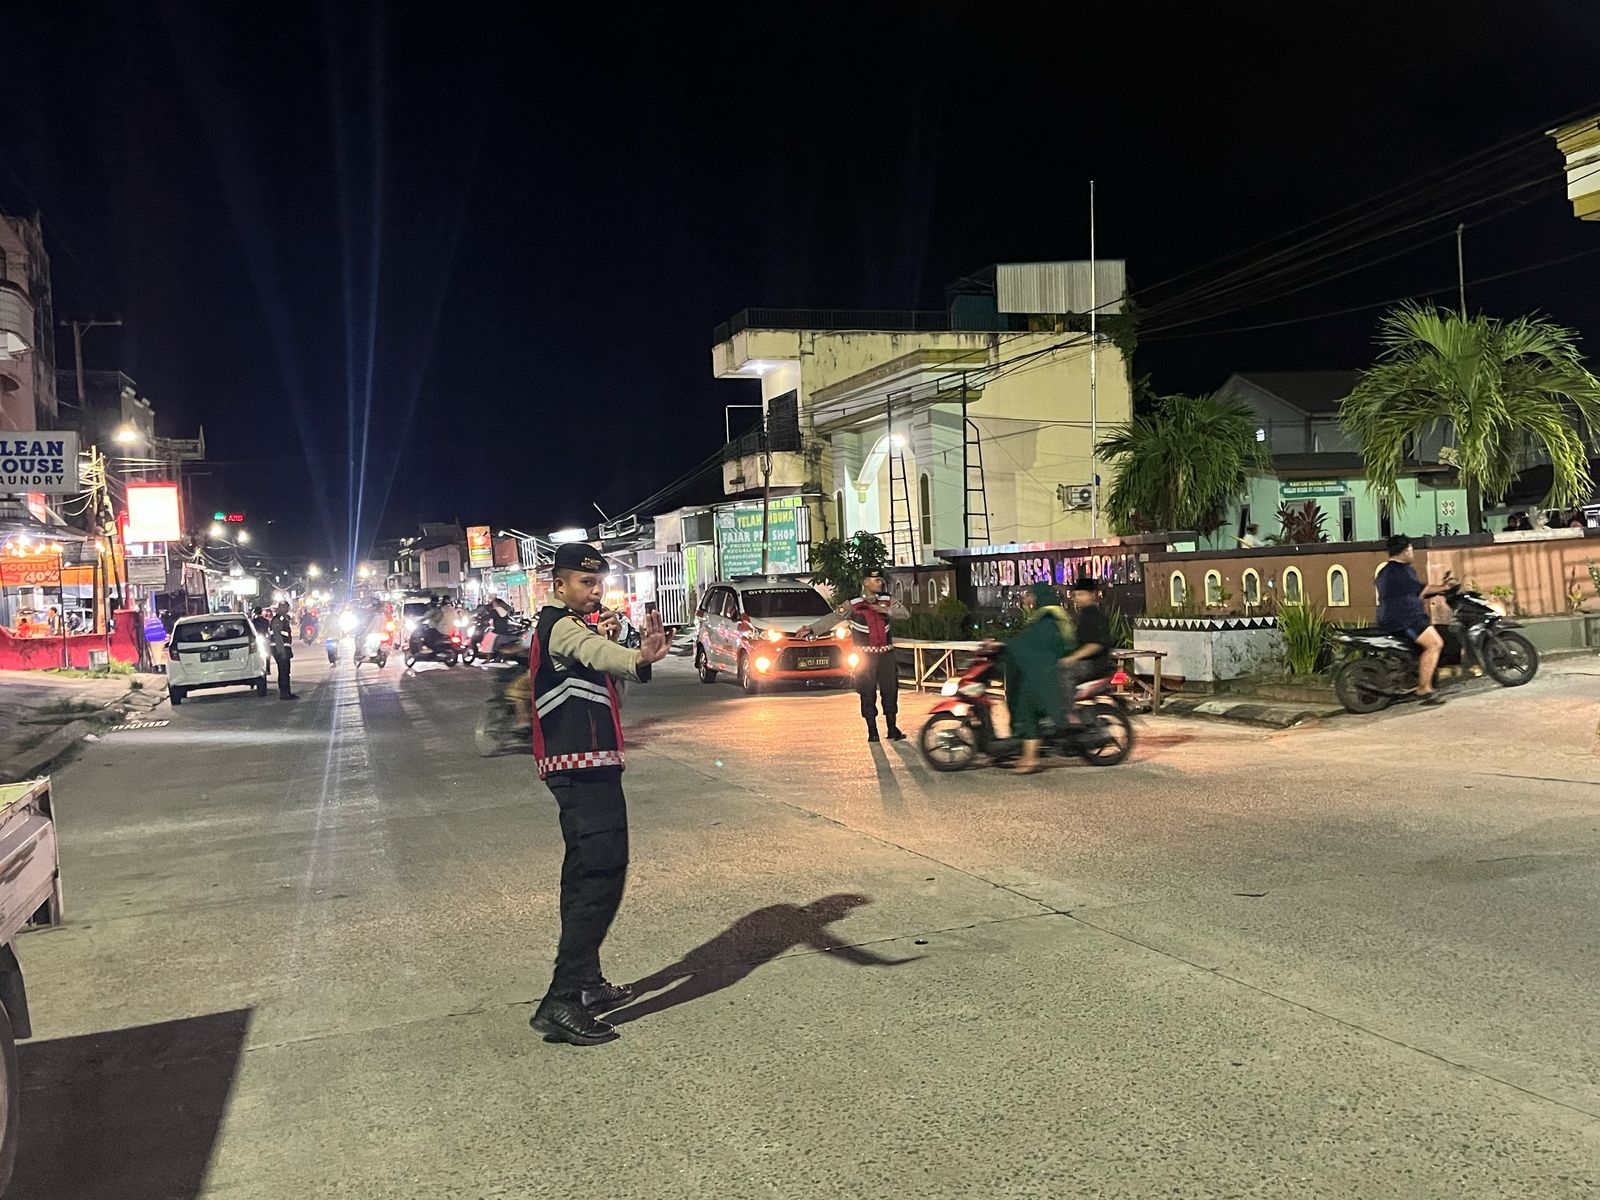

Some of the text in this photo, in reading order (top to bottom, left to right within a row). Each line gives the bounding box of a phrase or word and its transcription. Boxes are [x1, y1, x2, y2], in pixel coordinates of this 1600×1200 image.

[0, 458, 64, 474] OUSE
[736, 514, 763, 529] TELAH
[722, 530, 751, 543] FAJAR
[772, 528, 796, 540] SHOP
[25, 569, 60, 583] 40%
